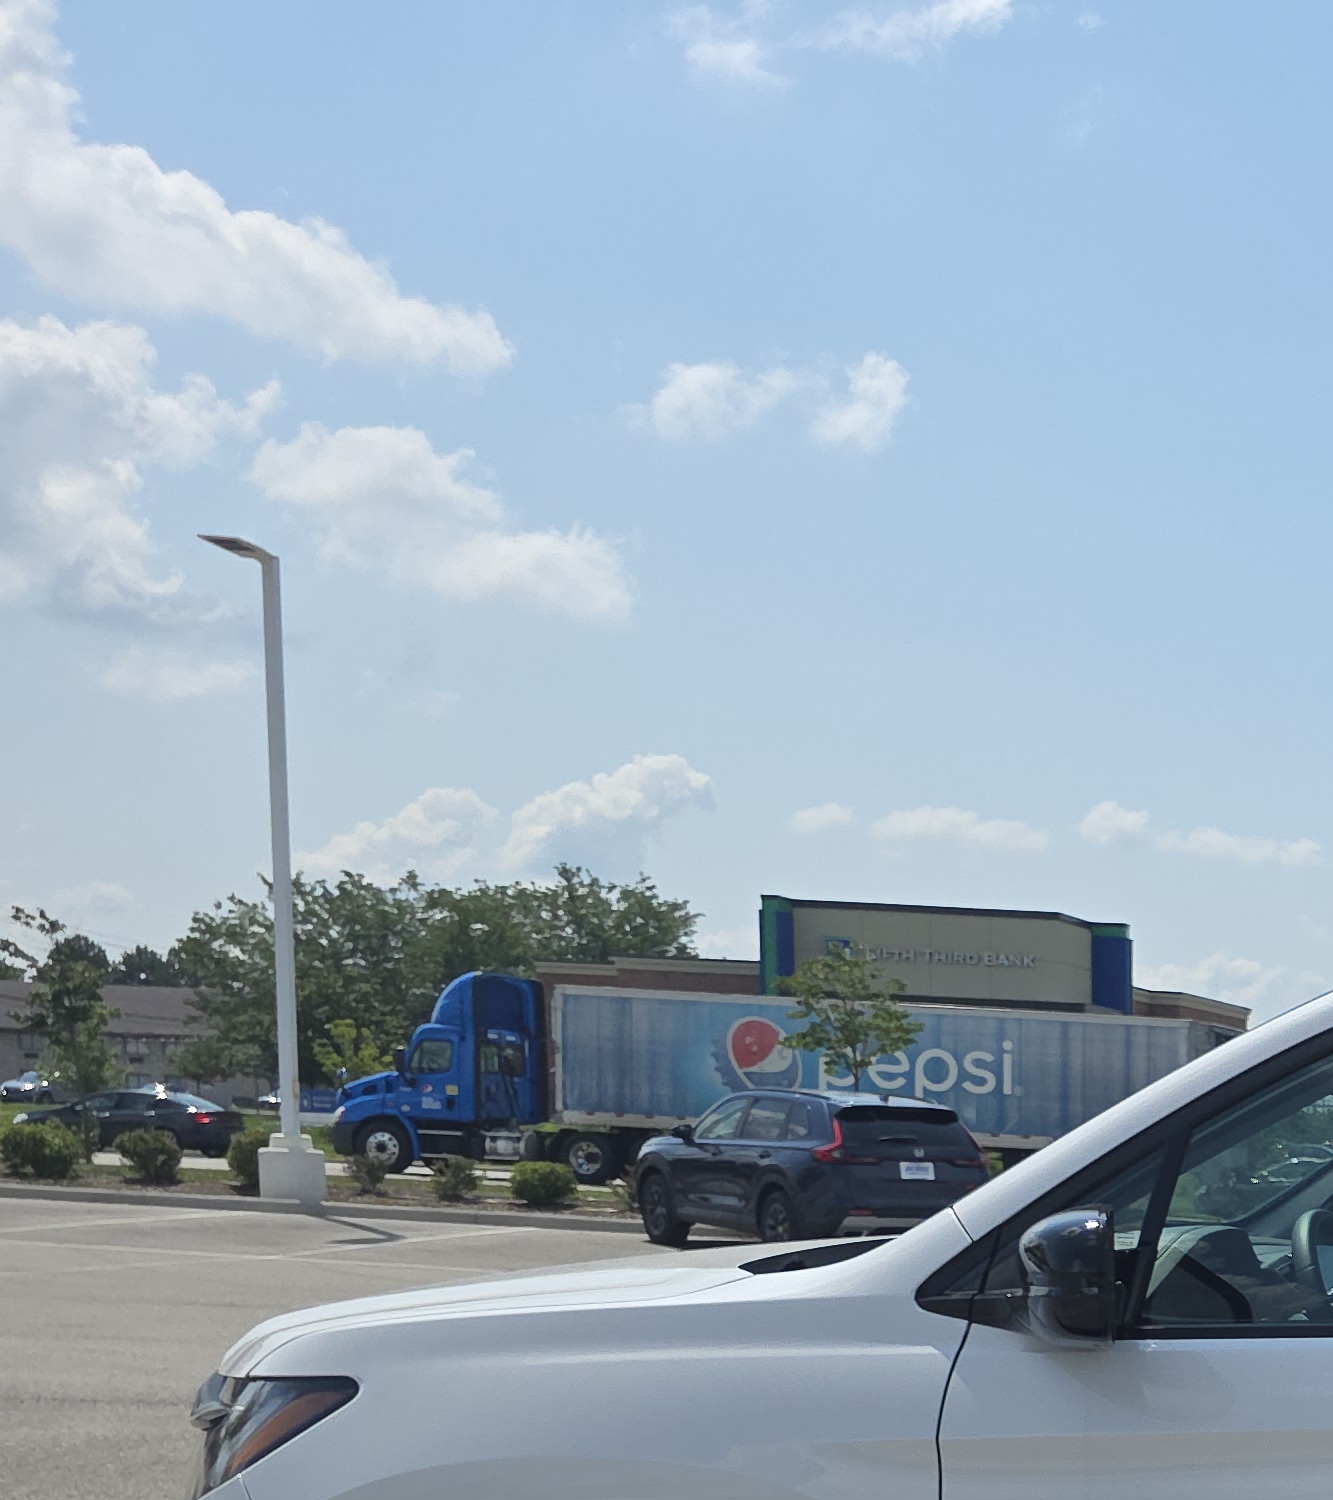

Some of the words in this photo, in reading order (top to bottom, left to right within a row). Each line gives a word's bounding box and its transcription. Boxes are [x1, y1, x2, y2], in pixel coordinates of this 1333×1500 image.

[923, 949, 979, 966] THIRD
[983, 952, 1036, 968] BANK
[818, 1040, 1013, 1098] pepsi
